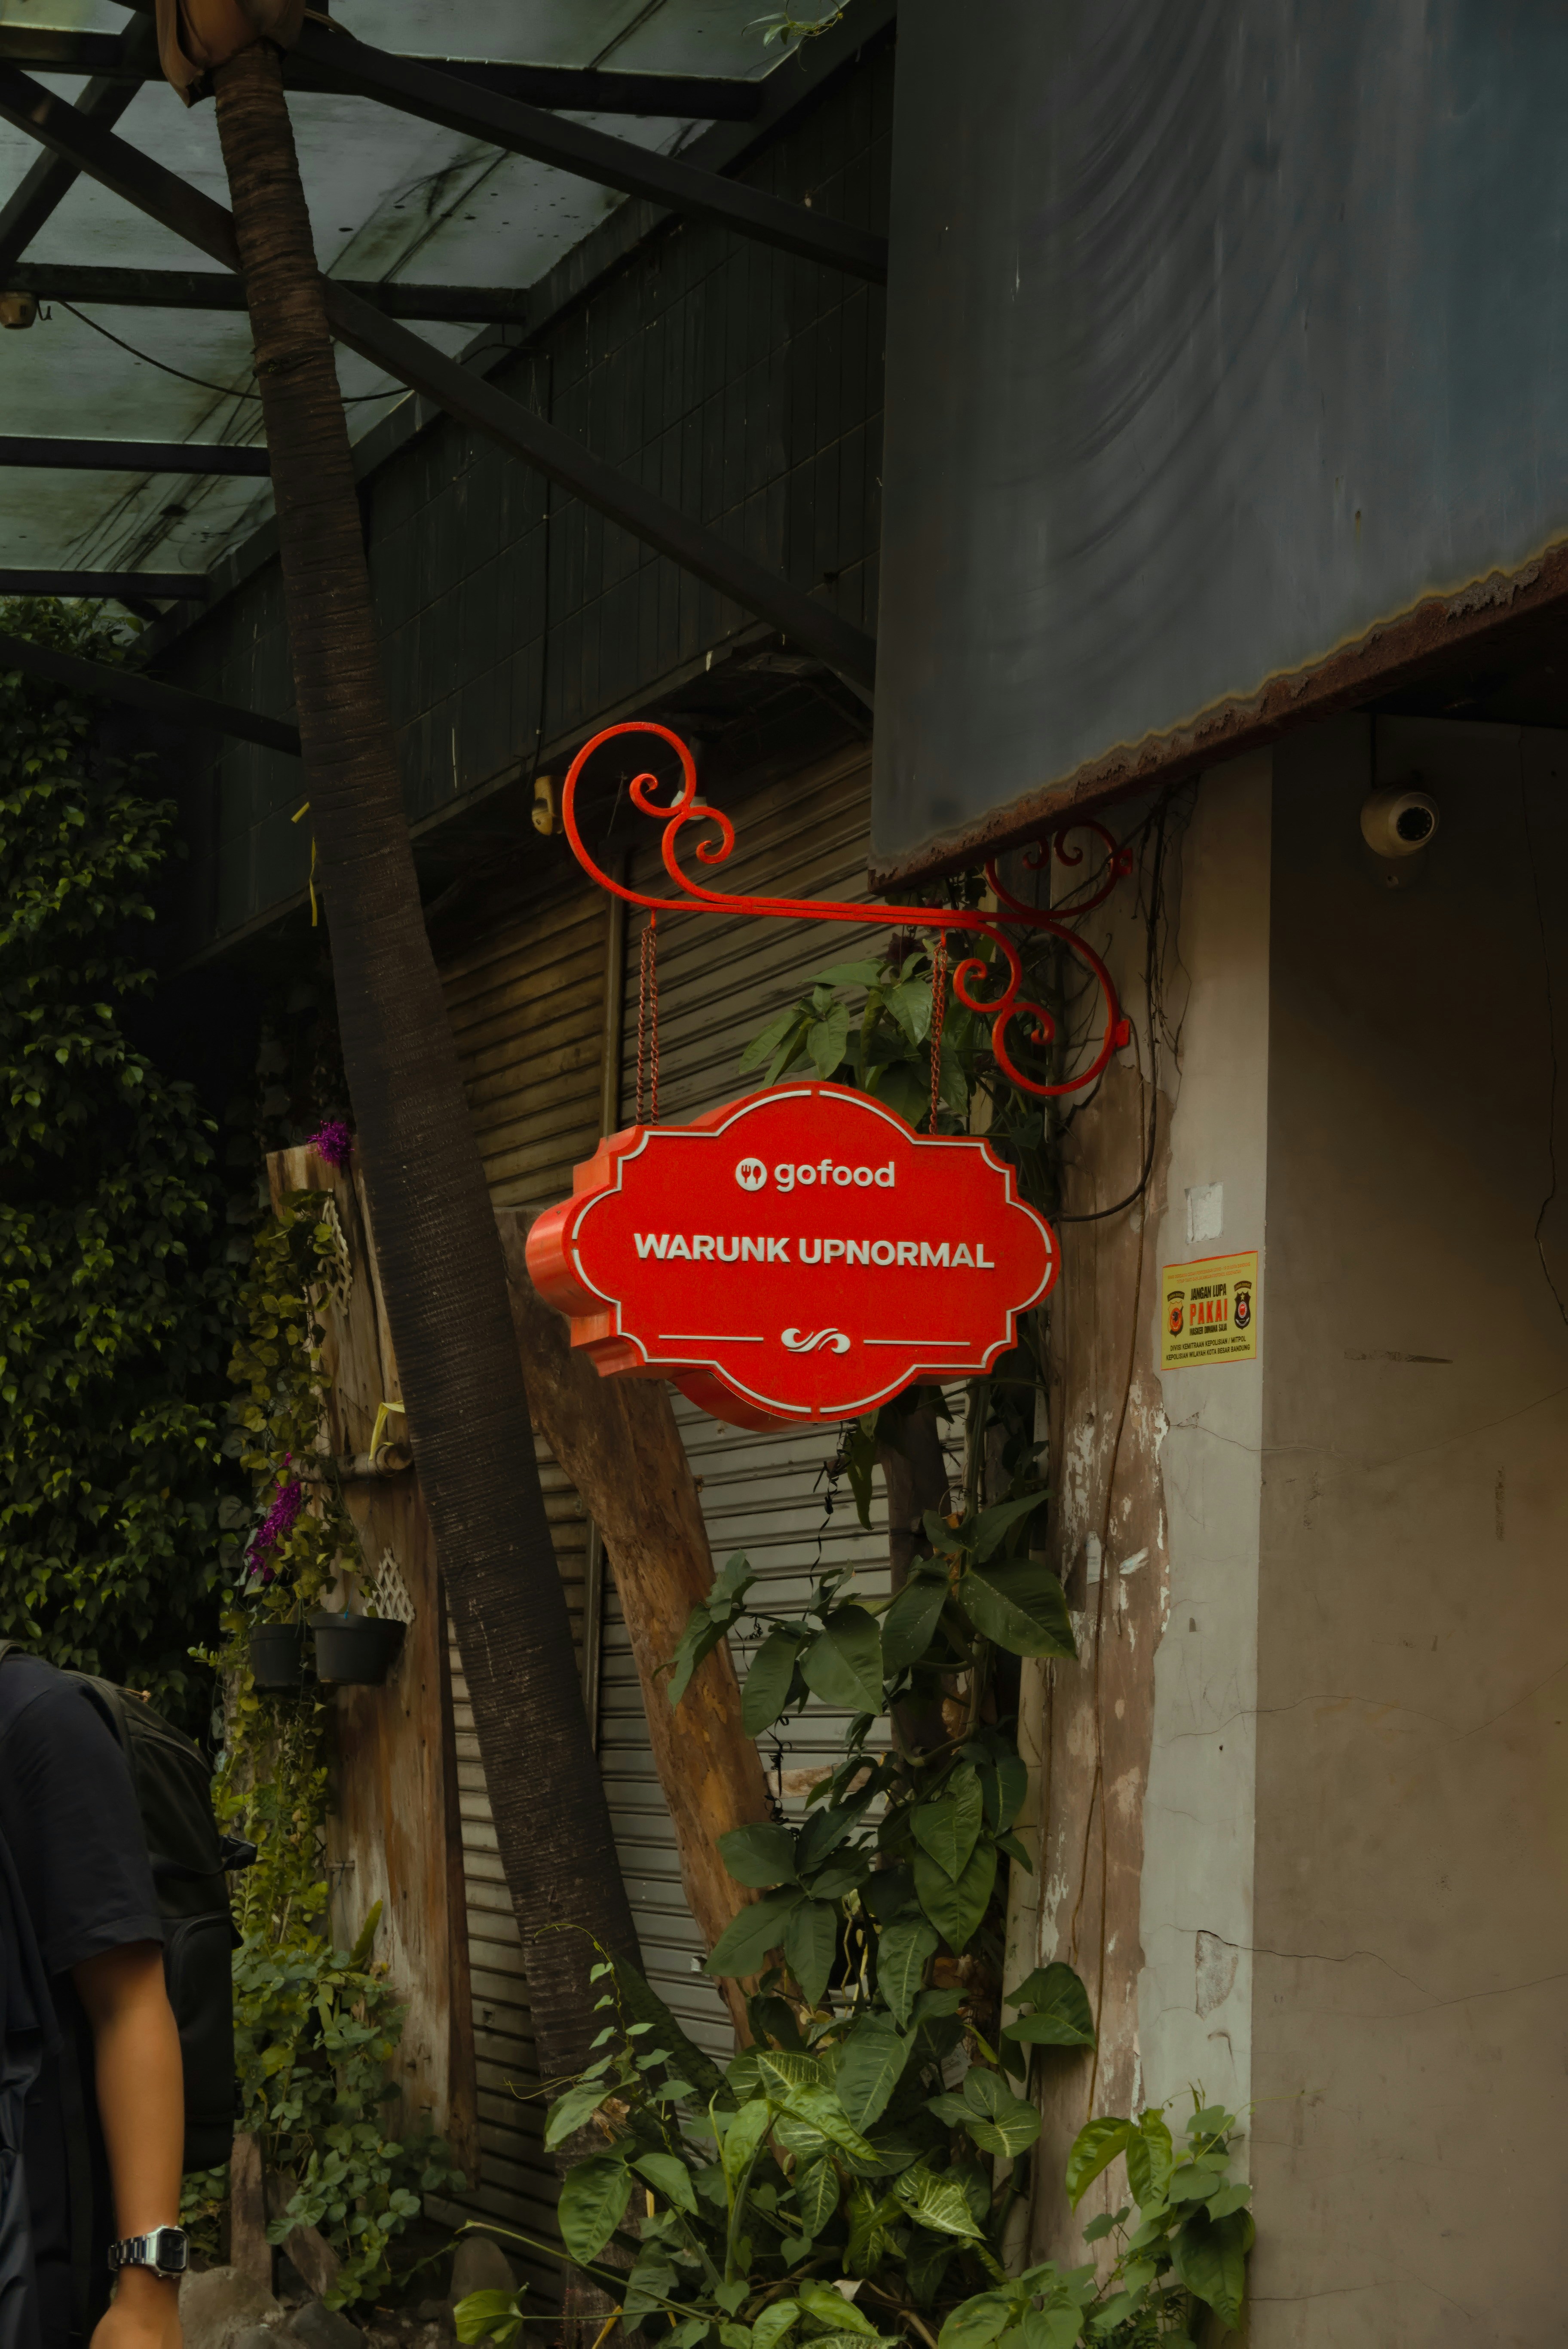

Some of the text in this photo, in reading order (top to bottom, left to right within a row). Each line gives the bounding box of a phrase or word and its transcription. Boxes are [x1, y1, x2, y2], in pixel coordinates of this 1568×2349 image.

[774, 1159, 895, 1192] gofood
[634, 1233, 995, 1269] WARUNK UPNORMAL
[1191, 1285, 1211, 1300] JANGAN
[1213, 1283, 1226, 1297] LUPA
[1190, 1298, 1228, 1325] PAKAI
[1189, 1327, 1203, 1336] MASKER
[1219, 1323, 1227, 1331] SAJA
[1166, 1352, 1188, 1361] KEPOLISIAN
[1189, 1350, 1206, 1358] WILAYAH
[1231, 1344, 1250, 1352] BANDUNG
[1182, 1341, 1204, 1350] KEMITRAAN
[1205, 1338, 1228, 1346] KEPOLISIAN
